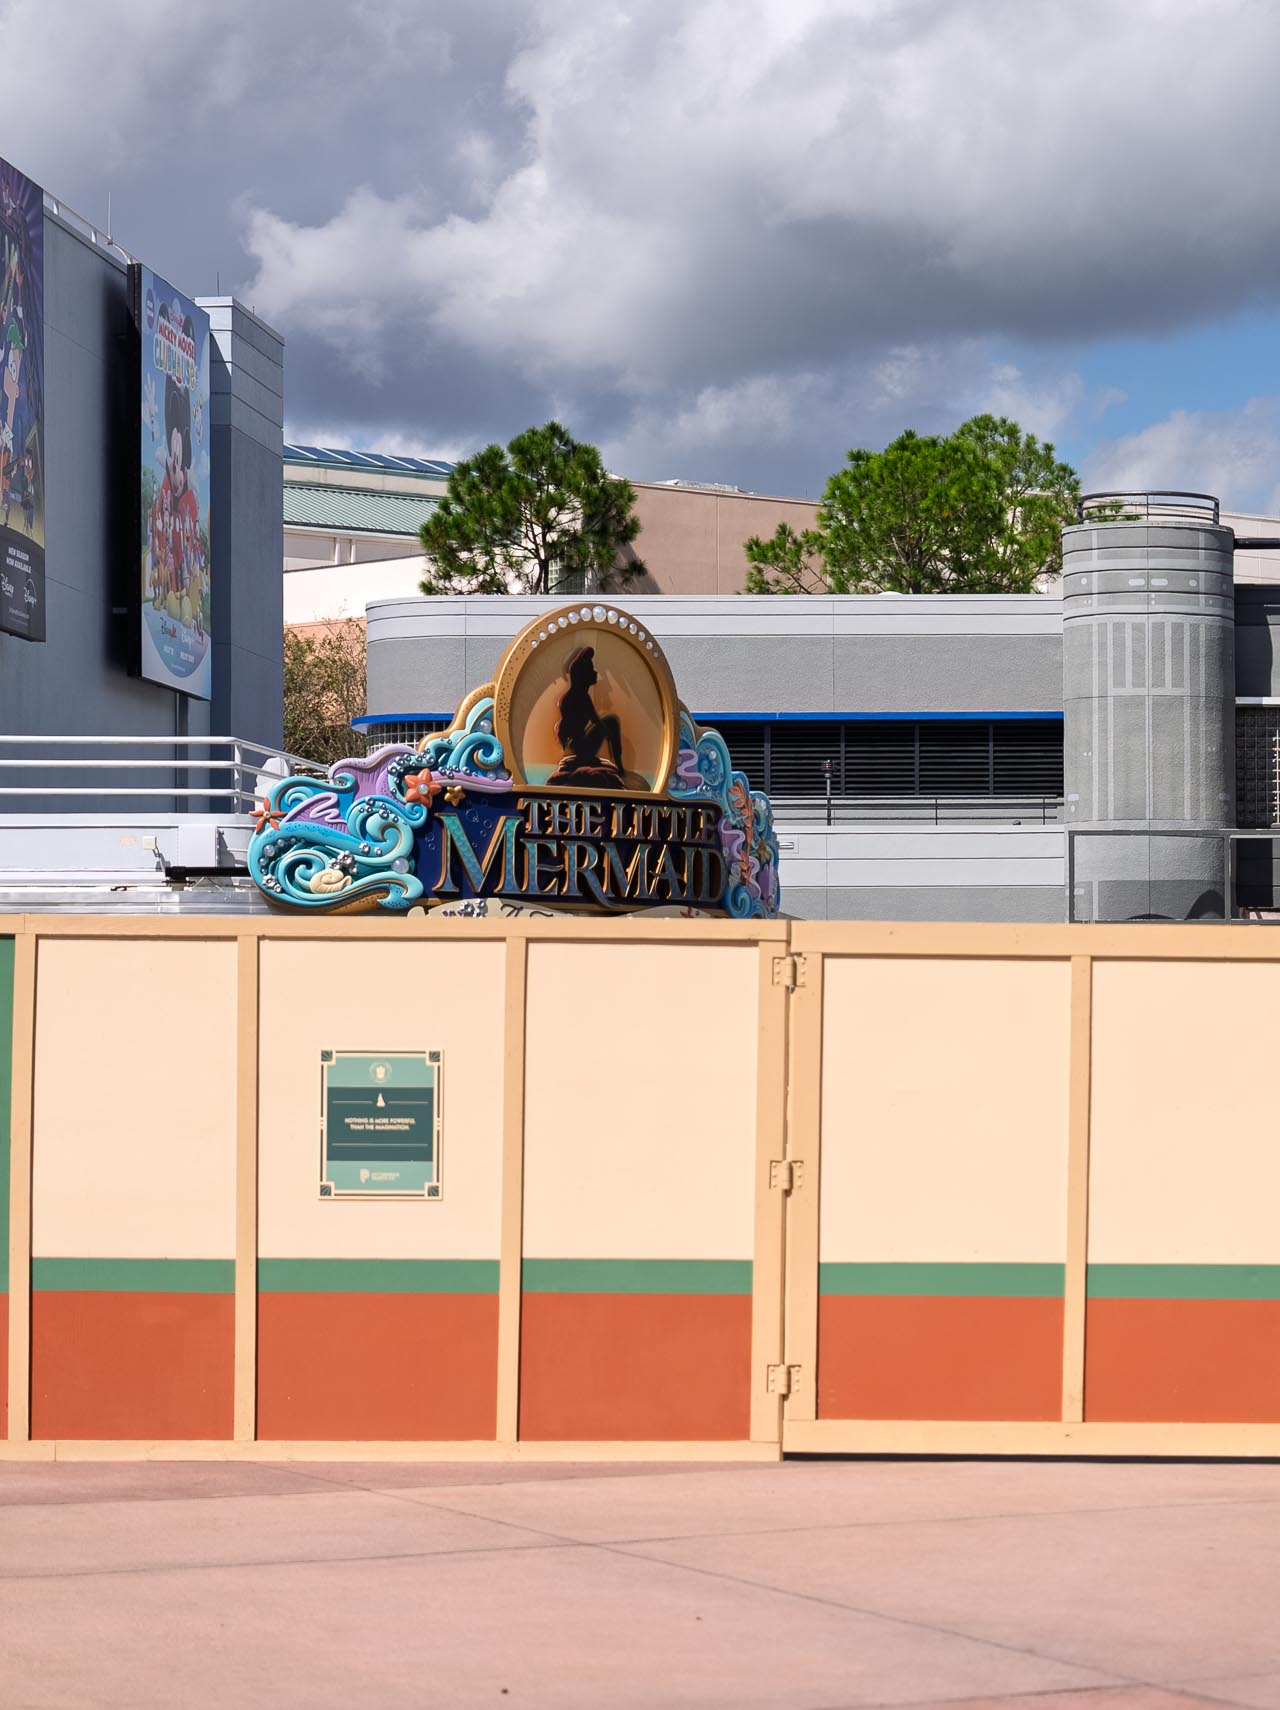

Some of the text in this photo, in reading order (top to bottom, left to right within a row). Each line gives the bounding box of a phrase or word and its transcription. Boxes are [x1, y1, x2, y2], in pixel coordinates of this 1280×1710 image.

[518, 798, 719, 845] THE LITTLE
[432, 811, 728, 908] MERMAID
